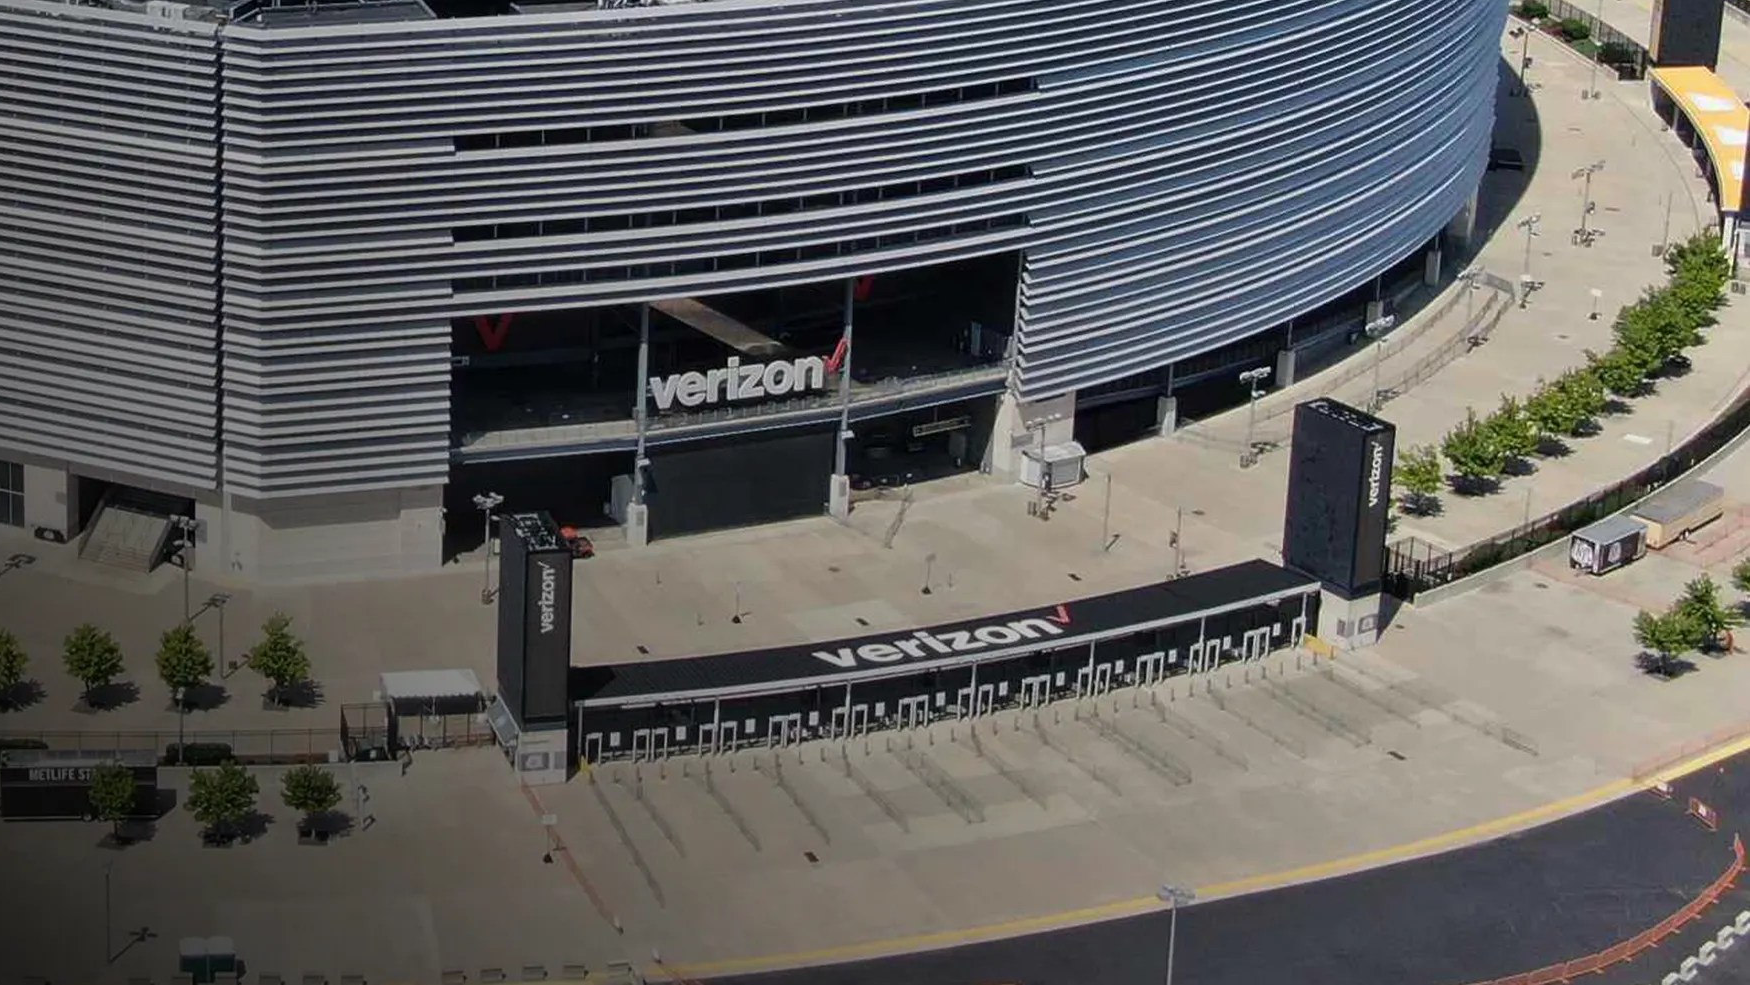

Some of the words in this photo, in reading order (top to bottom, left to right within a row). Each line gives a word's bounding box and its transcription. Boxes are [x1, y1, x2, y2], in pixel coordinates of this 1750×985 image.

[648, 355, 824, 410] verizon
[1368, 445, 1383, 507] verizon
[538, 568, 555, 633] verizon
[811, 616, 1065, 668] verizon
[29, 767, 75, 782] METLIFE
